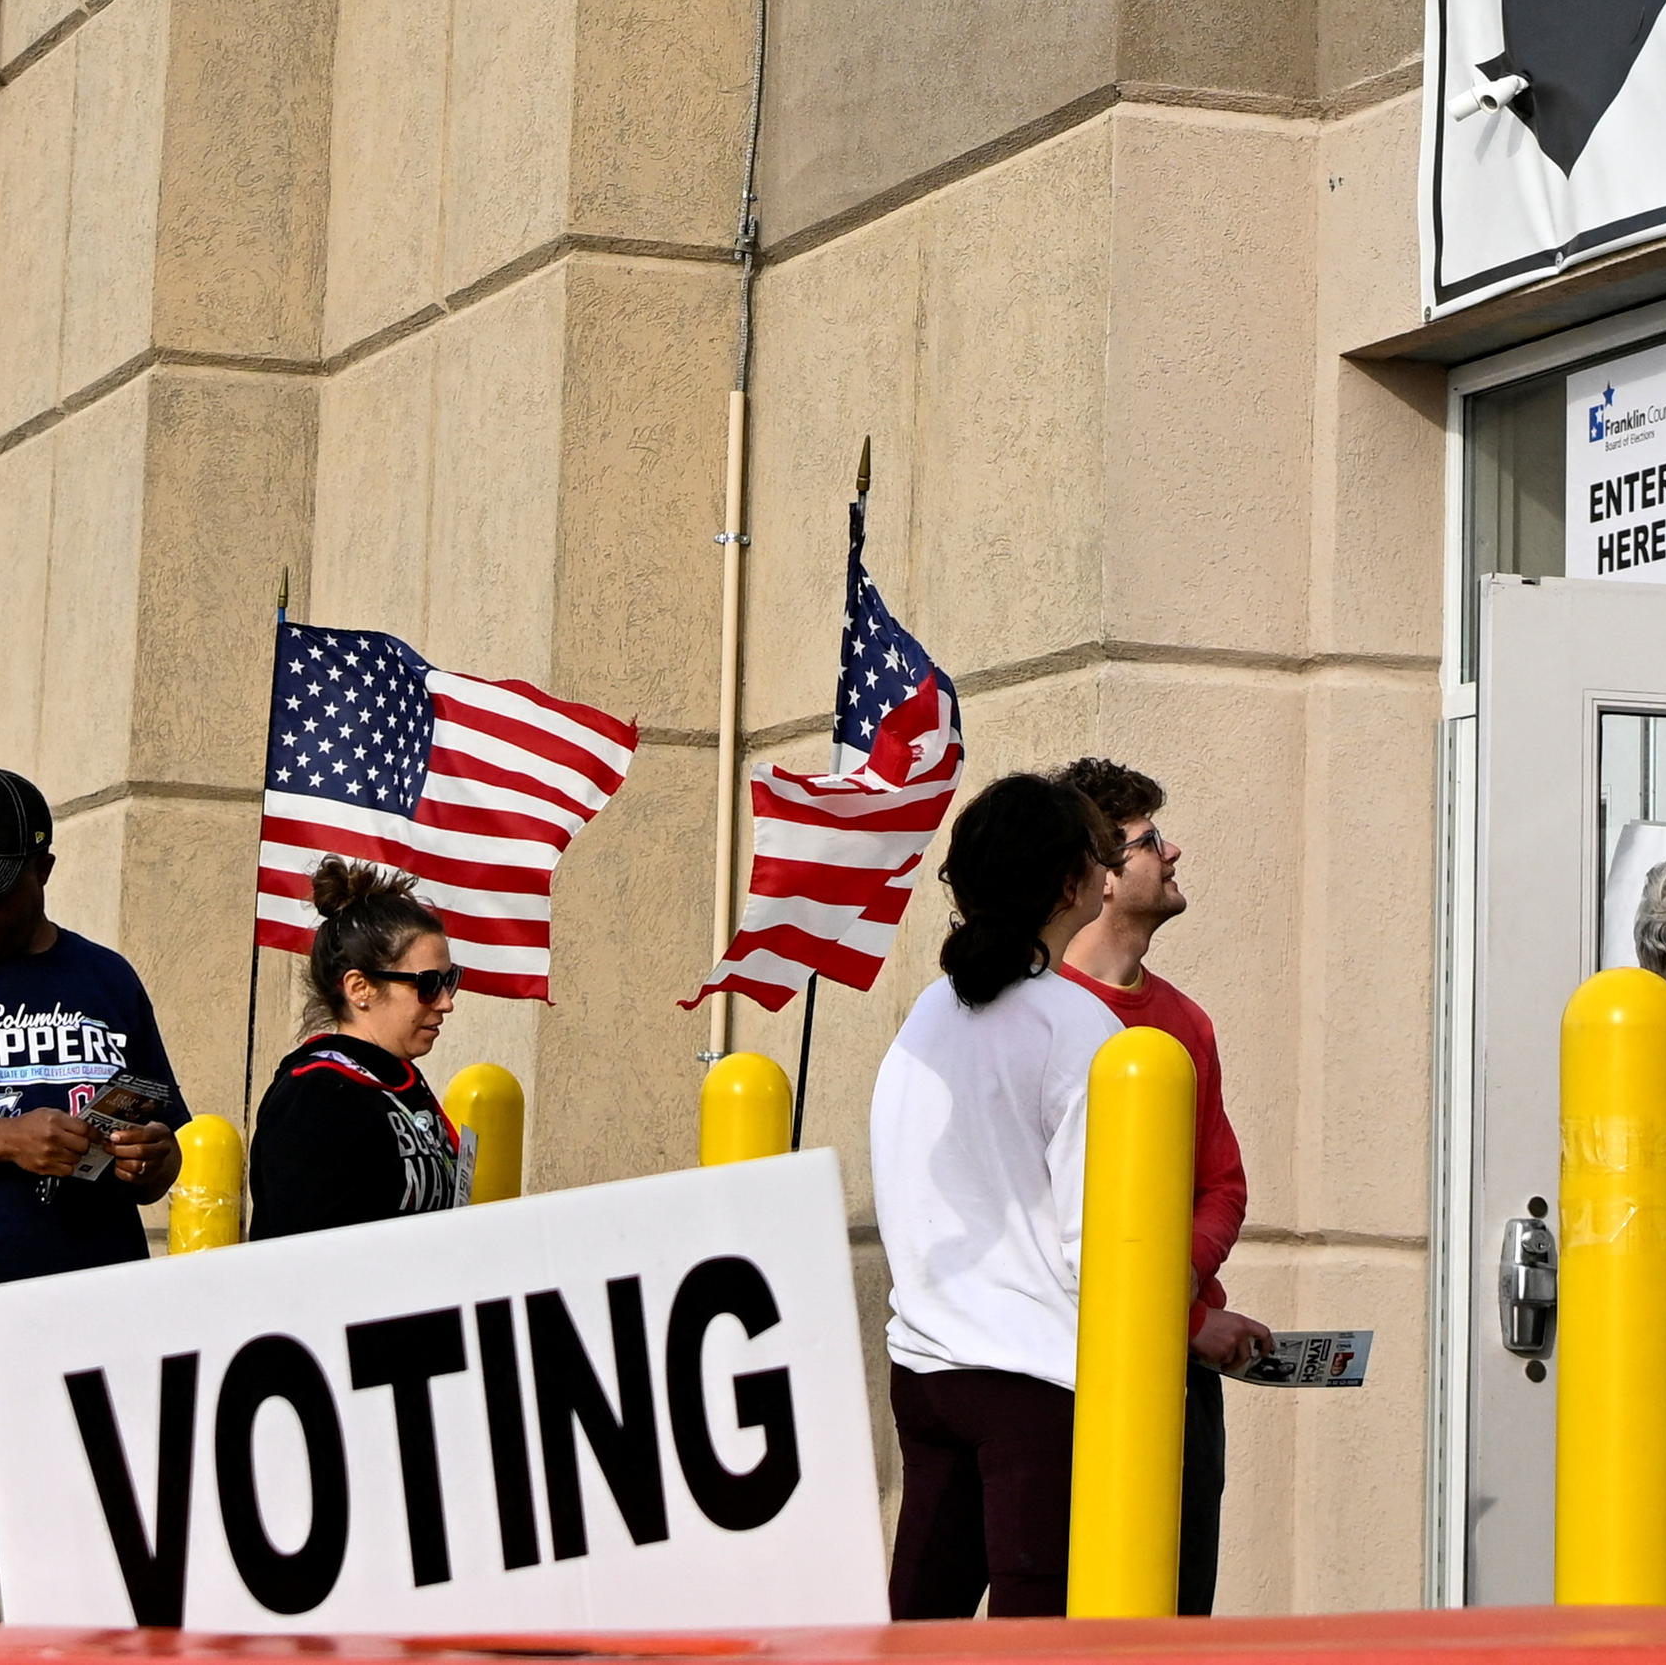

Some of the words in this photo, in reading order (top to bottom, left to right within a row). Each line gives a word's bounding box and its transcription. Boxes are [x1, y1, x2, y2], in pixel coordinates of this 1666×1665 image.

[1605, 409, 1646, 437] Franklin
[1605, 438, 1622, 452] Board
[1622, 436, 1630, 446] of
[1630, 430, 1655, 446] Elections
[1598, 519, 1666, 576] HERE
[1300, 1338, 1324, 1383] LYNCH
[64, 1256, 801, 1627] VOTING
